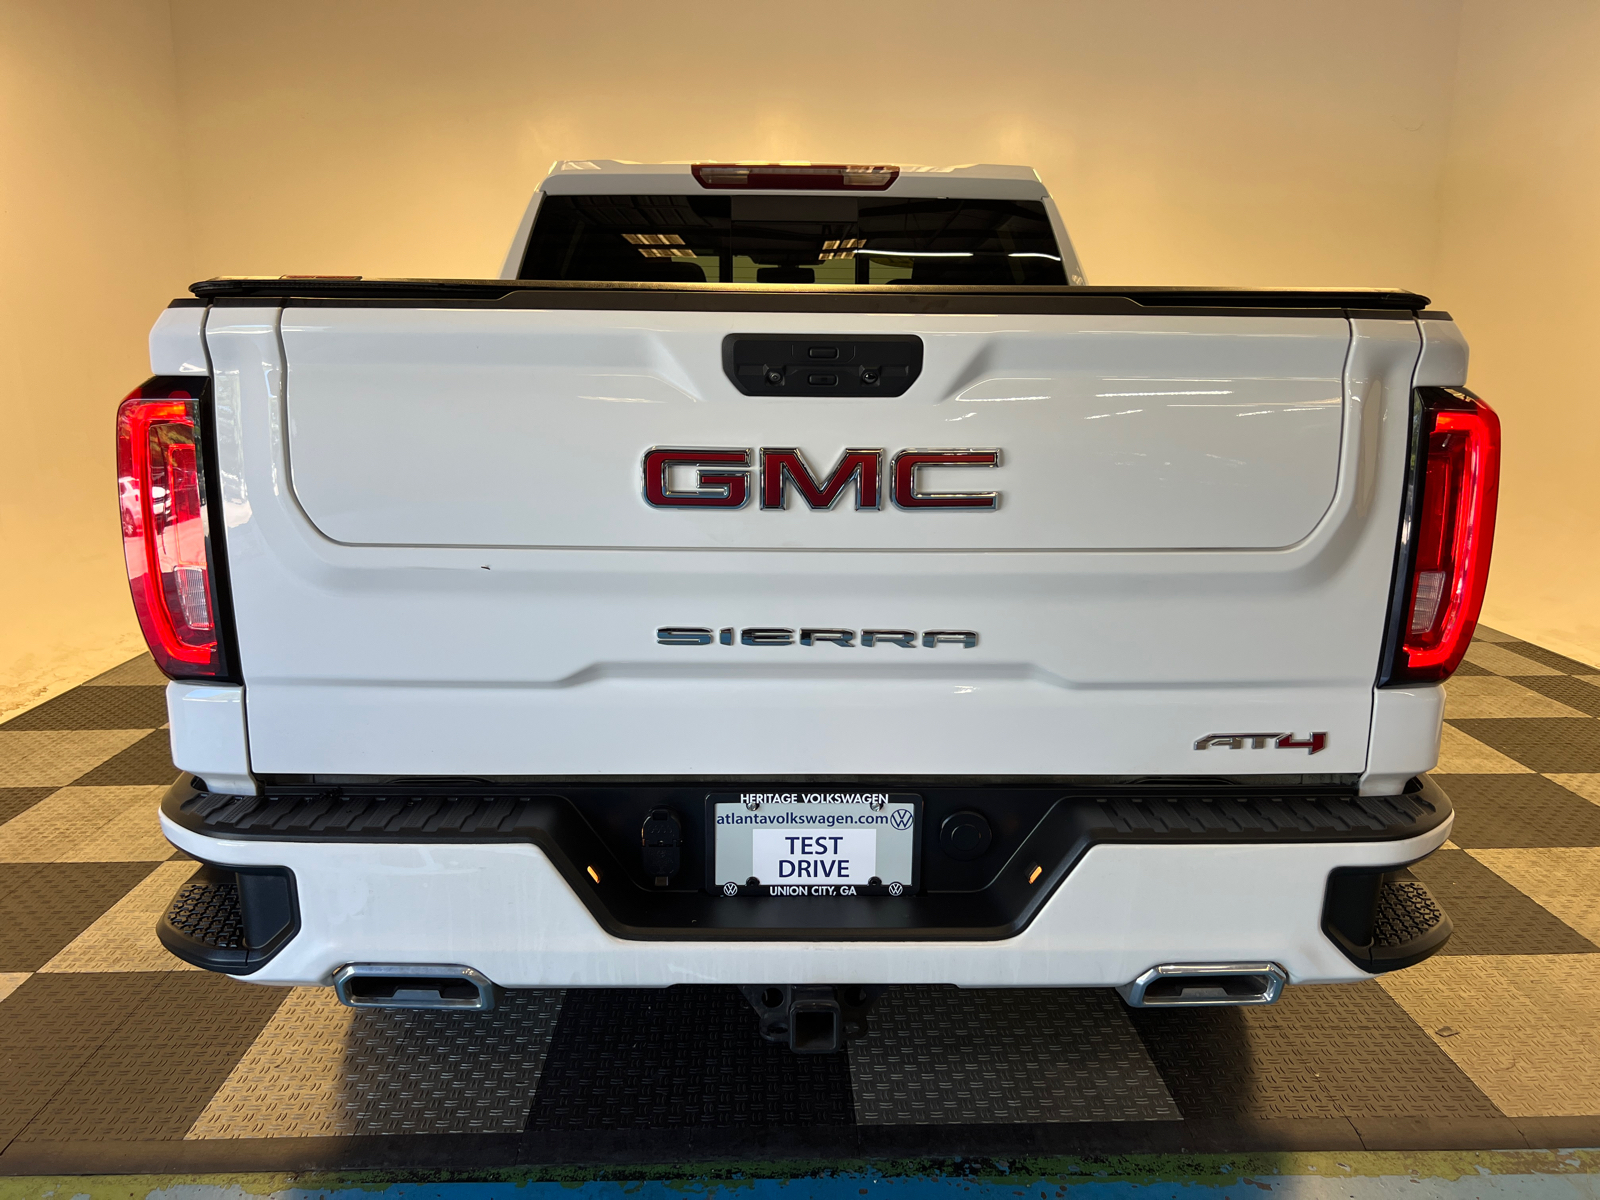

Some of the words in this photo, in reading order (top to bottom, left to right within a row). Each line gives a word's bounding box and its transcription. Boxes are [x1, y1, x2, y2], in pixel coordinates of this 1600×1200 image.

[641, 445, 1001, 511] GMC
[656, 626, 979, 649] SIERRA
[1194, 732, 1327, 755] AT4
[740, 793, 798, 804] HERITAGE
[801, 793, 889, 804] VOLKSWAGEN
[716, 812, 889, 827] atlantavolkswagen.com
[785, 836, 843, 855] TEST
[778, 859, 850, 878] DRIVE
[769, 886, 808, 896] UNION
[811, 886, 837, 897] CITY,
[840, 886, 857, 896] GA
